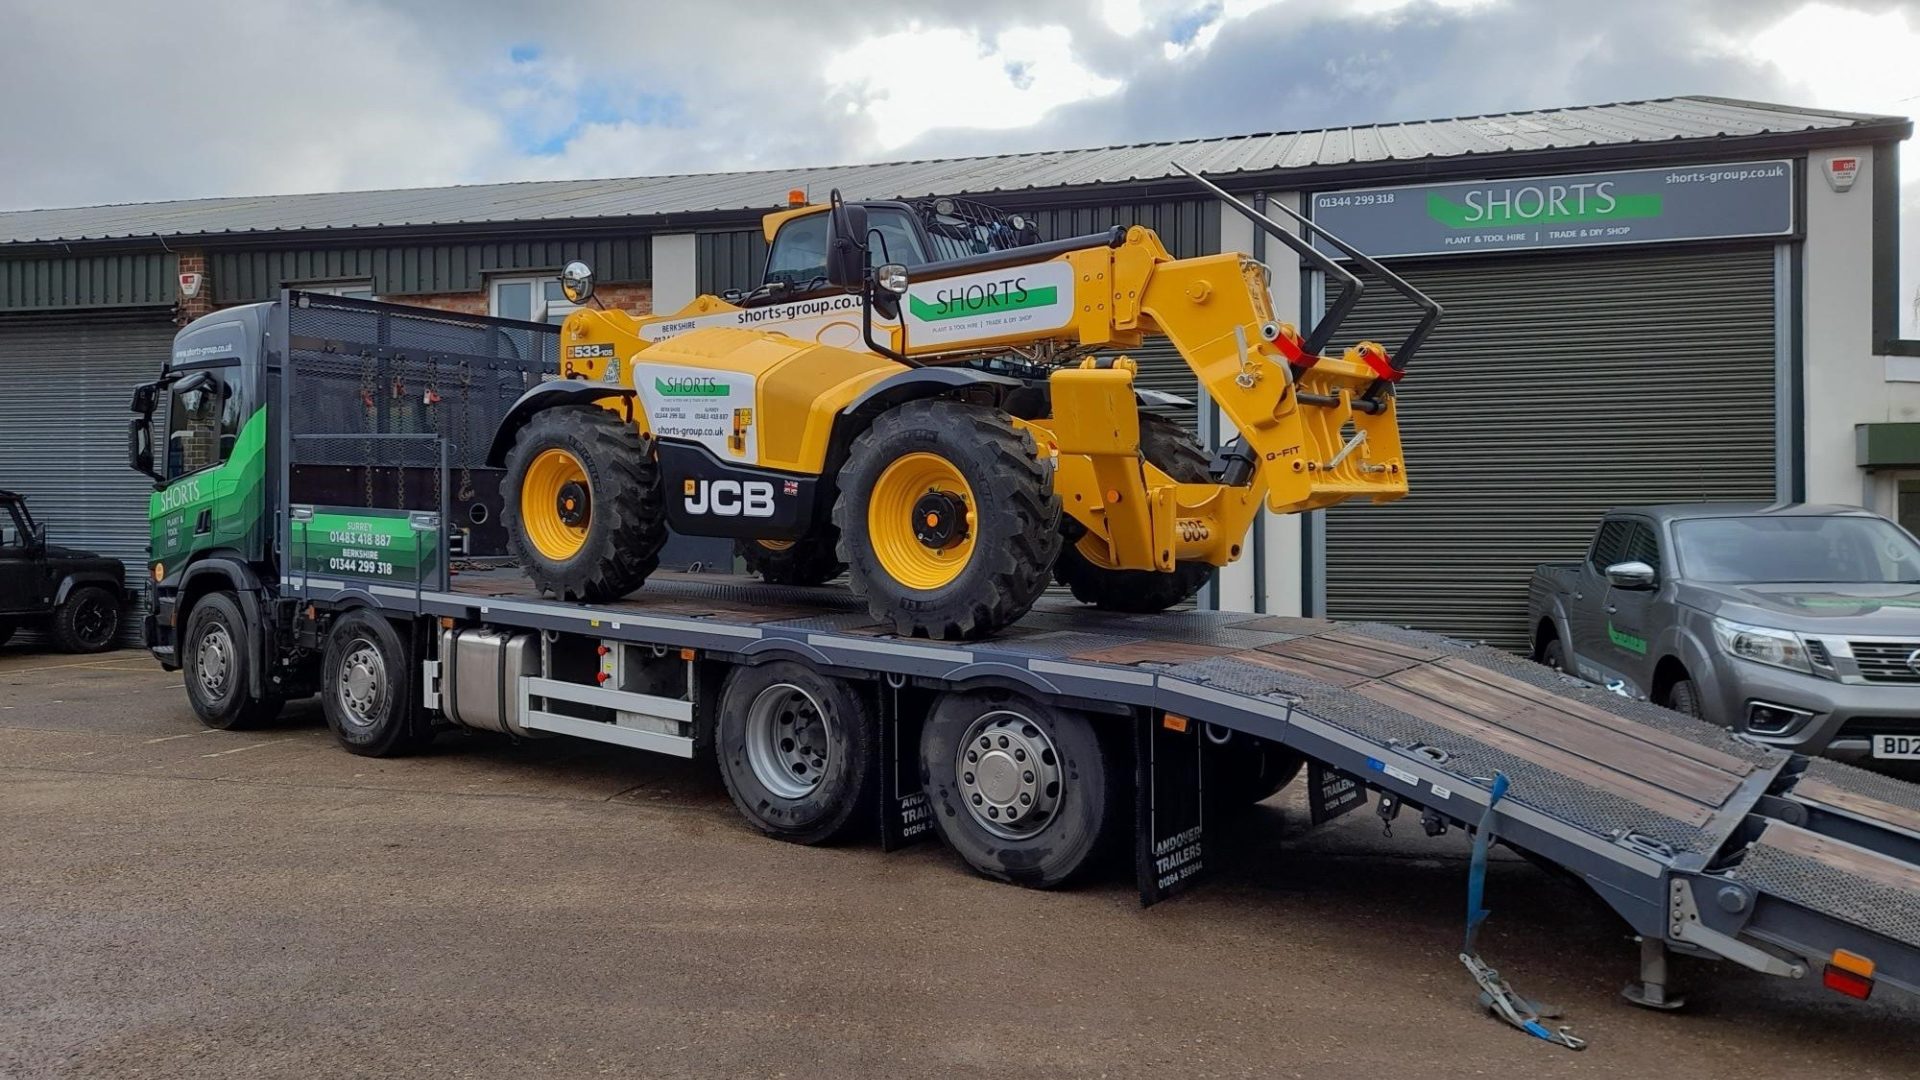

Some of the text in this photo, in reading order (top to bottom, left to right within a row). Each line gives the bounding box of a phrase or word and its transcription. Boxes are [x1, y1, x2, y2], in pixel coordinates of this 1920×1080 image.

[1665, 165, 1784, 184] shorts-group.co.uk
[1319, 193, 1395, 208] 01344 299 318
[1464, 181, 1616, 222] SHORTS
[1445, 236, 1471, 245] PLANT
[1474, 235, 1481, 243] &
[1483, 234, 1505, 243] TOOL
[1507, 233, 1527, 241] HIRE
[1549, 230, 1577, 239] TRADE
[1580, 229, 1587, 237] &
[1606, 226, 1630, 236] SHOP
[936, 277, 1028, 315] SHORTS
[738, 294, 864, 324] shorts-group.co.u
[662, 321, 696, 333] BERKSHIRE
[667, 377, 716, 393] SHORTS
[657, 427, 724, 436] shorts-group.co.uk
[1266, 446, 1300, 461] Q-FIT
[160, 480, 200, 512] SHORTS
[684, 480, 775, 517] JCB
[347, 522, 373, 531] SURREY
[329, 531, 391, 547] 01483 418 887
[342, 548, 378, 560] BERKSHIRE
[329, 557, 393, 575] 01344 299 318
[1156, 826, 1202, 857] ANDOVER
[1156, 842, 1202, 874] TRAILERS
[1158, 872, 1179, 889] 01264
